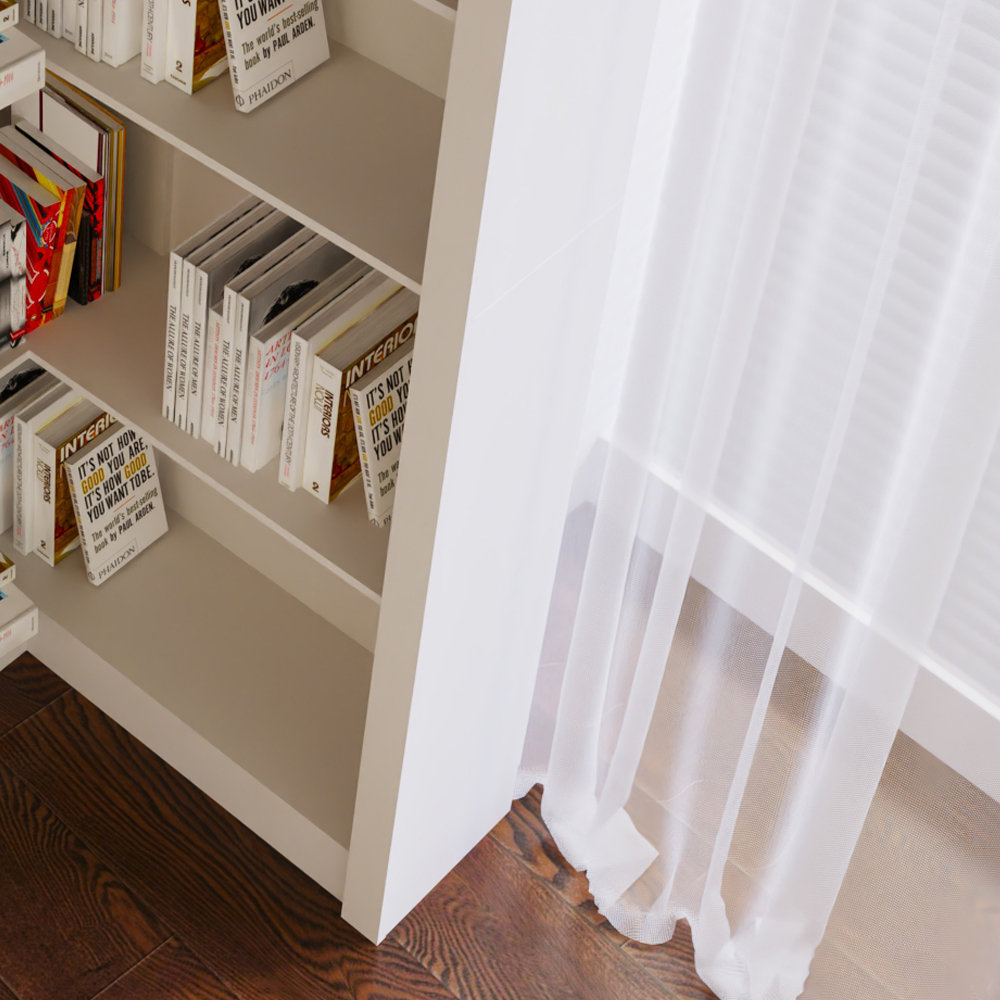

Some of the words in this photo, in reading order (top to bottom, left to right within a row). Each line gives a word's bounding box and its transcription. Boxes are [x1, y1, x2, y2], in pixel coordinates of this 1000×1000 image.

[236, 3, 258, 30] YOU
[241, 40, 254, 55] The
[256, 23, 280, 44] world's
[281, 0, 320, 30] best-selling
[244, 52, 261, 70] book
[262, 44, 270, 58] by
[272, 32, 290, 52] PAUL
[292, 16, 316, 39] ARDEN.
[176, 60, 184, 72] 2
[248, 68, 292, 104] PHAIDON
[345, 322, 416, 389] INTERIO
[366, 383, 385, 409] IT'S
[386, 365, 404, 393] NOT
[368, 394, 394, 426] GOOD
[396, 382, 408, 404] YO
[320, 390, 334, 438] INTERIORS
[371, 418, 390, 444] IT'S
[78, 457, 96, 480] IT'S
[96, 442, 114, 466] NOT
[117, 430, 136, 450] HOW
[374, 434, 393, 460] YOU
[81, 468, 105, 494] GOOD
[107, 451, 125, 474] YOU
[84, 488, 102, 510] IT'S
[102, 470, 122, 495] HOW
[124, 452, 148, 479] GOOD
[86, 500, 106, 524] YOU
[104, 482, 129, 510] WANT
[118, 518, 134, 535] PAUL
